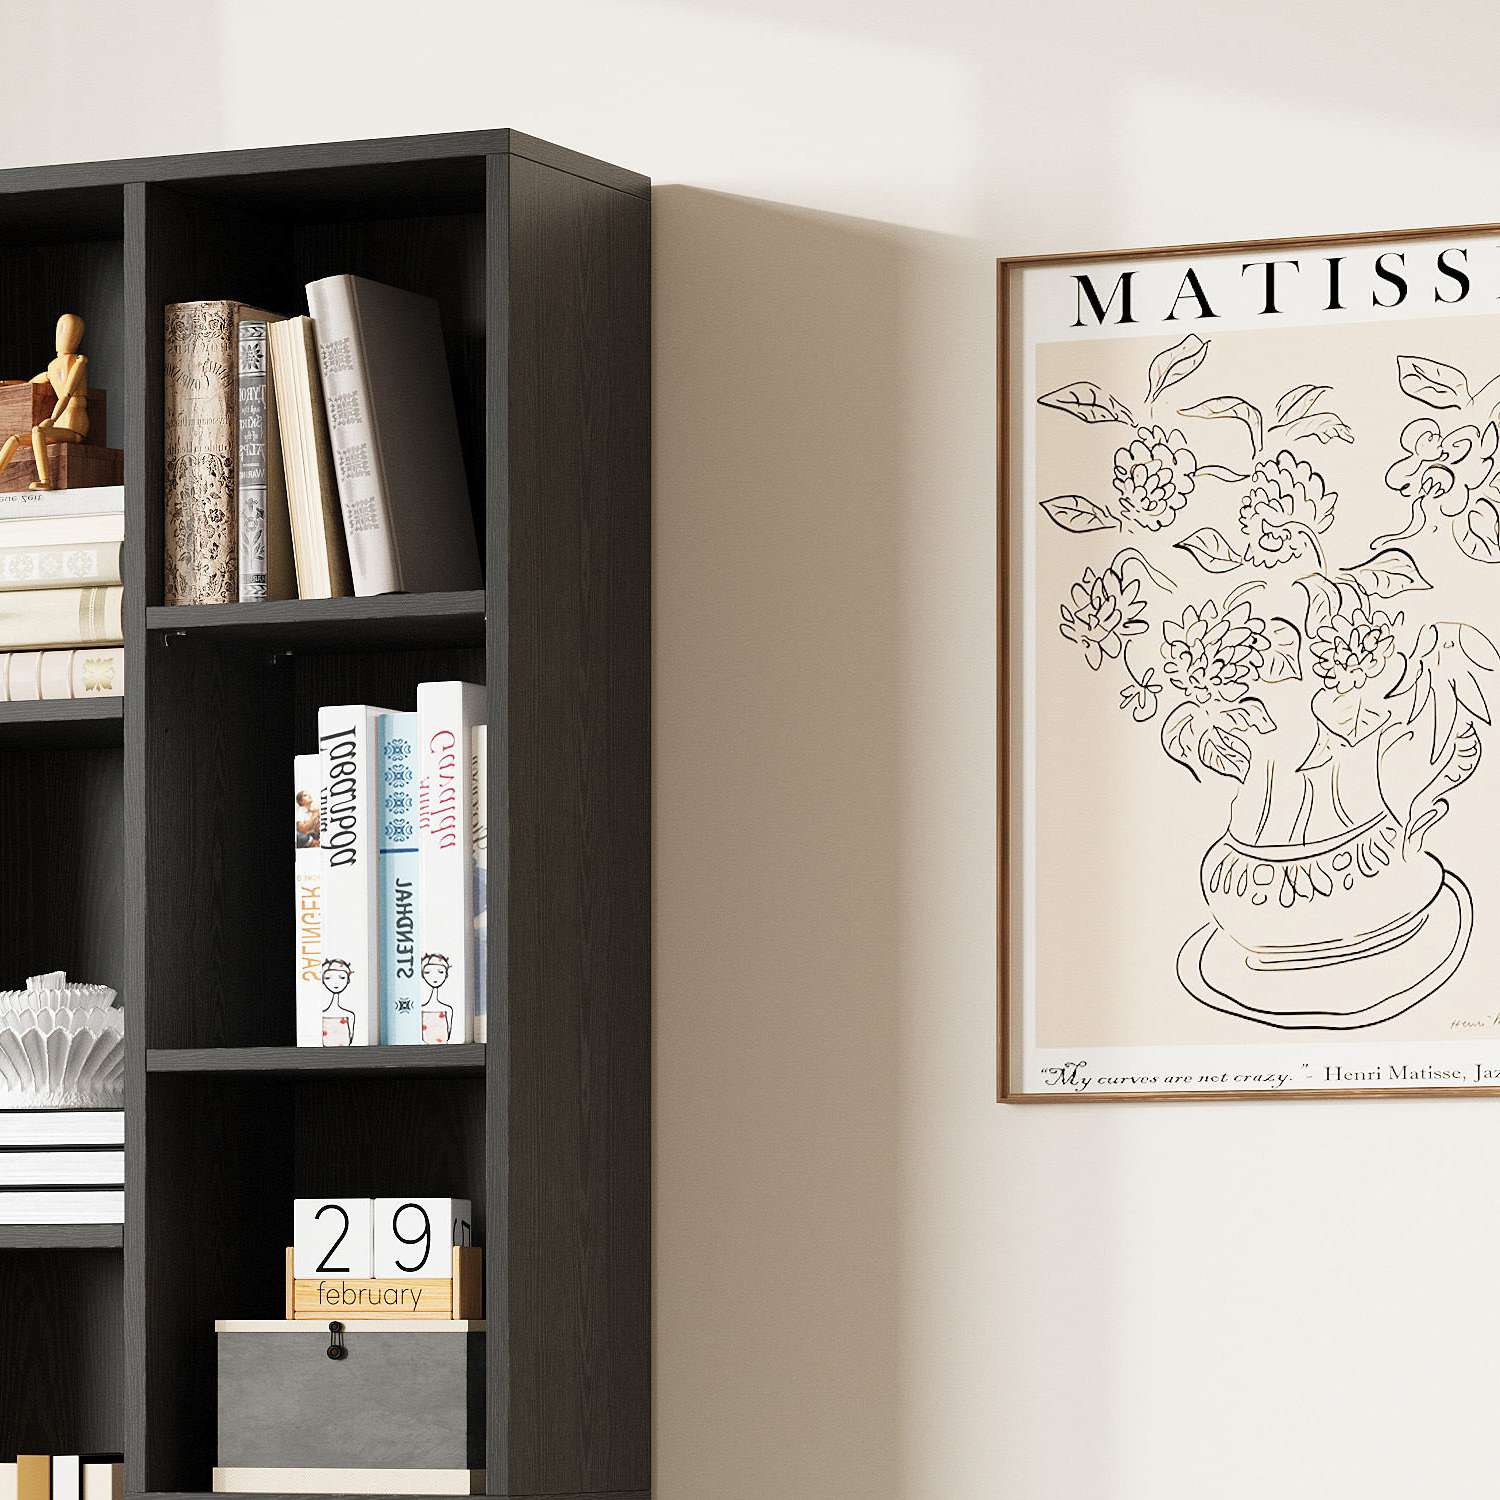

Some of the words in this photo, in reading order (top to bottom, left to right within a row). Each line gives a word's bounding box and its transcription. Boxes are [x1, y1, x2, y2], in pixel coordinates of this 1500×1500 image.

[1069, 247, 1500, 328] MATISS
[1097, 1071, 1160, 1086] curves
[1165, 1073, 1194, 1085] are
[1197, 1067, 1230, 1085] not
[1233, 1070, 1293, 1089] crazy.
[1324, 1063, 1382, 1083] Henri
[1387, 1062, 1467, 1085] Matisse,
[317, 1280, 423, 1312] february
